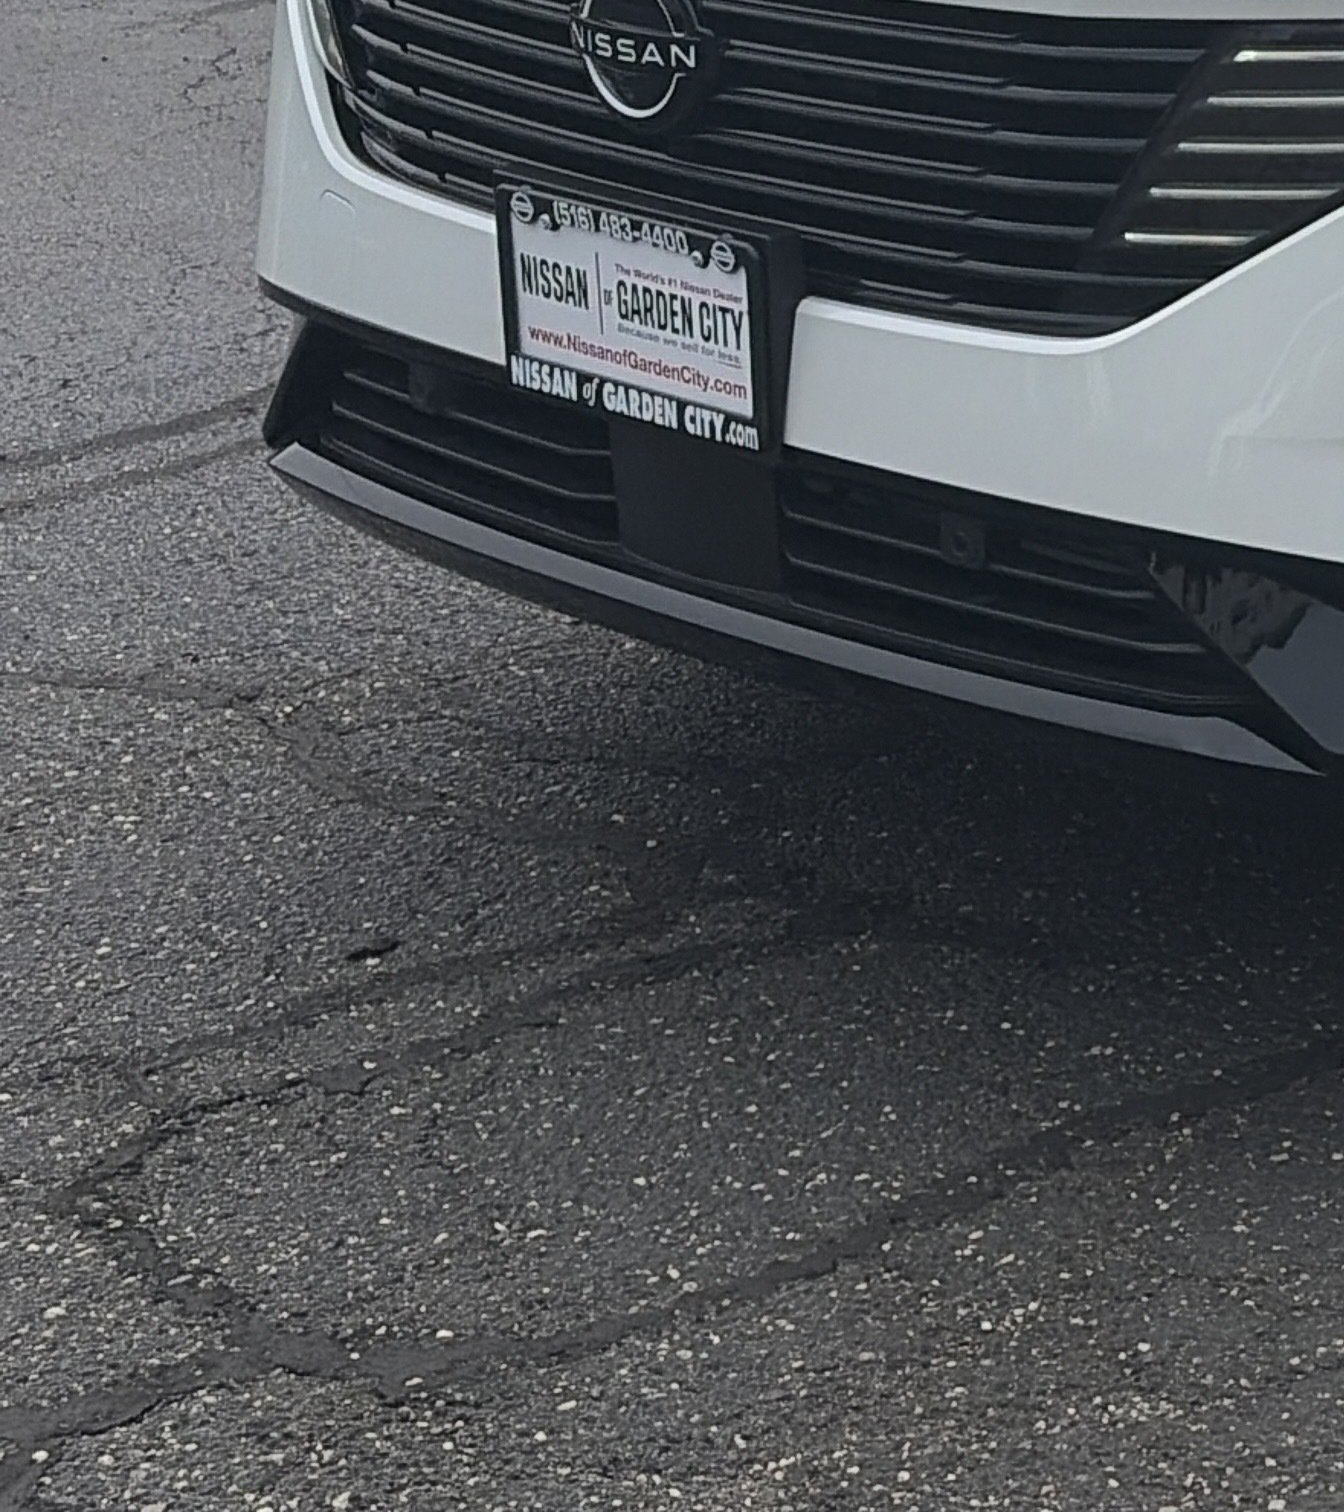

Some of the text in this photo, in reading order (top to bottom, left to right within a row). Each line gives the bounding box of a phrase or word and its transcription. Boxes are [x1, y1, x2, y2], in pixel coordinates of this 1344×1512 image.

[571, 20, 697, 69] NISSAN
[552, 199, 690, 255] (516) 483-4400
[519, 252, 590, 310] NISSAN
[616, 279, 694, 339] GARDEN
[699, 301, 744, 351] CITY
[510, 354, 578, 402] NISSAN
[582, 377, 600, 406] of
[602, 382, 678, 429] GARDEN
[527, 325, 748, 400] www.NissanofGardenCity.com
